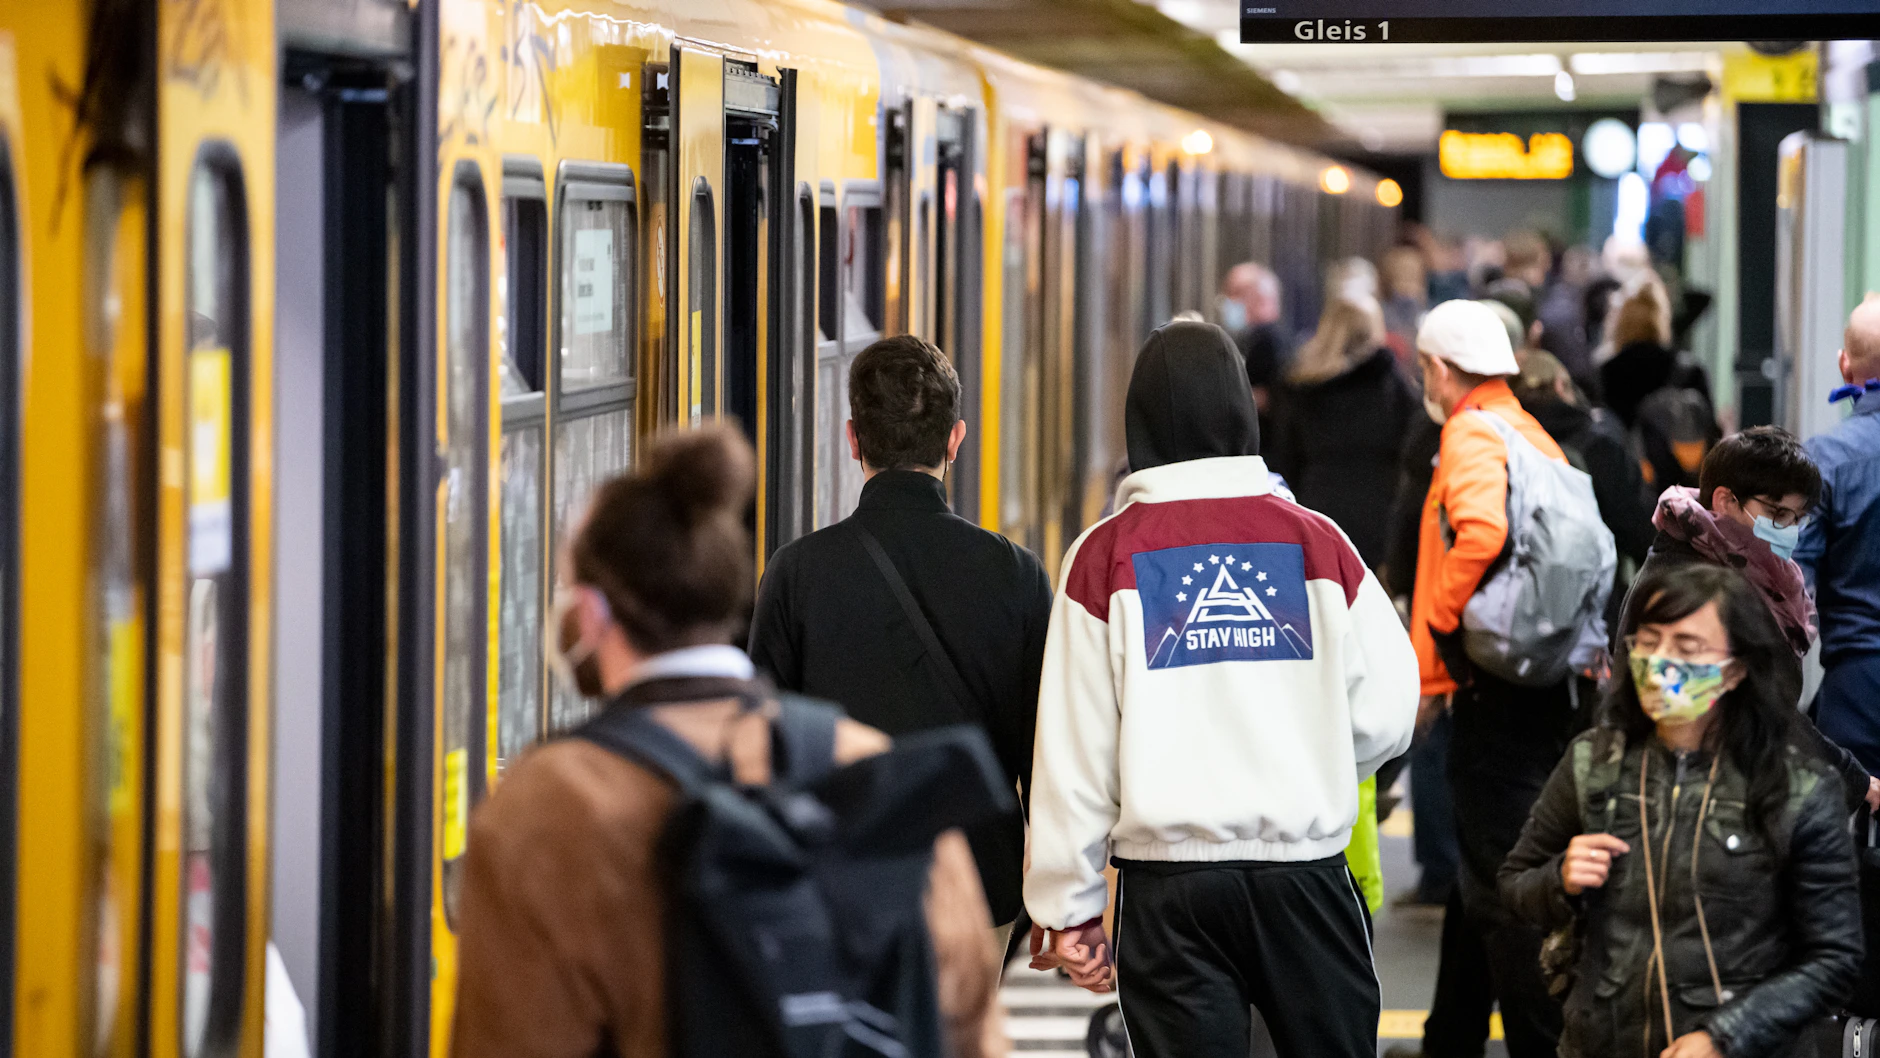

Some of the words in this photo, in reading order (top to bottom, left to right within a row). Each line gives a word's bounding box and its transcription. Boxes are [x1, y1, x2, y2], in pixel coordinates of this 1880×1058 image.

[1294, 19, 1367, 41] Gleis
[1377, 20, 1389, 41] 1
[1186, 627, 1232, 650] STAY
[1233, 626, 1276, 648] HIGH
